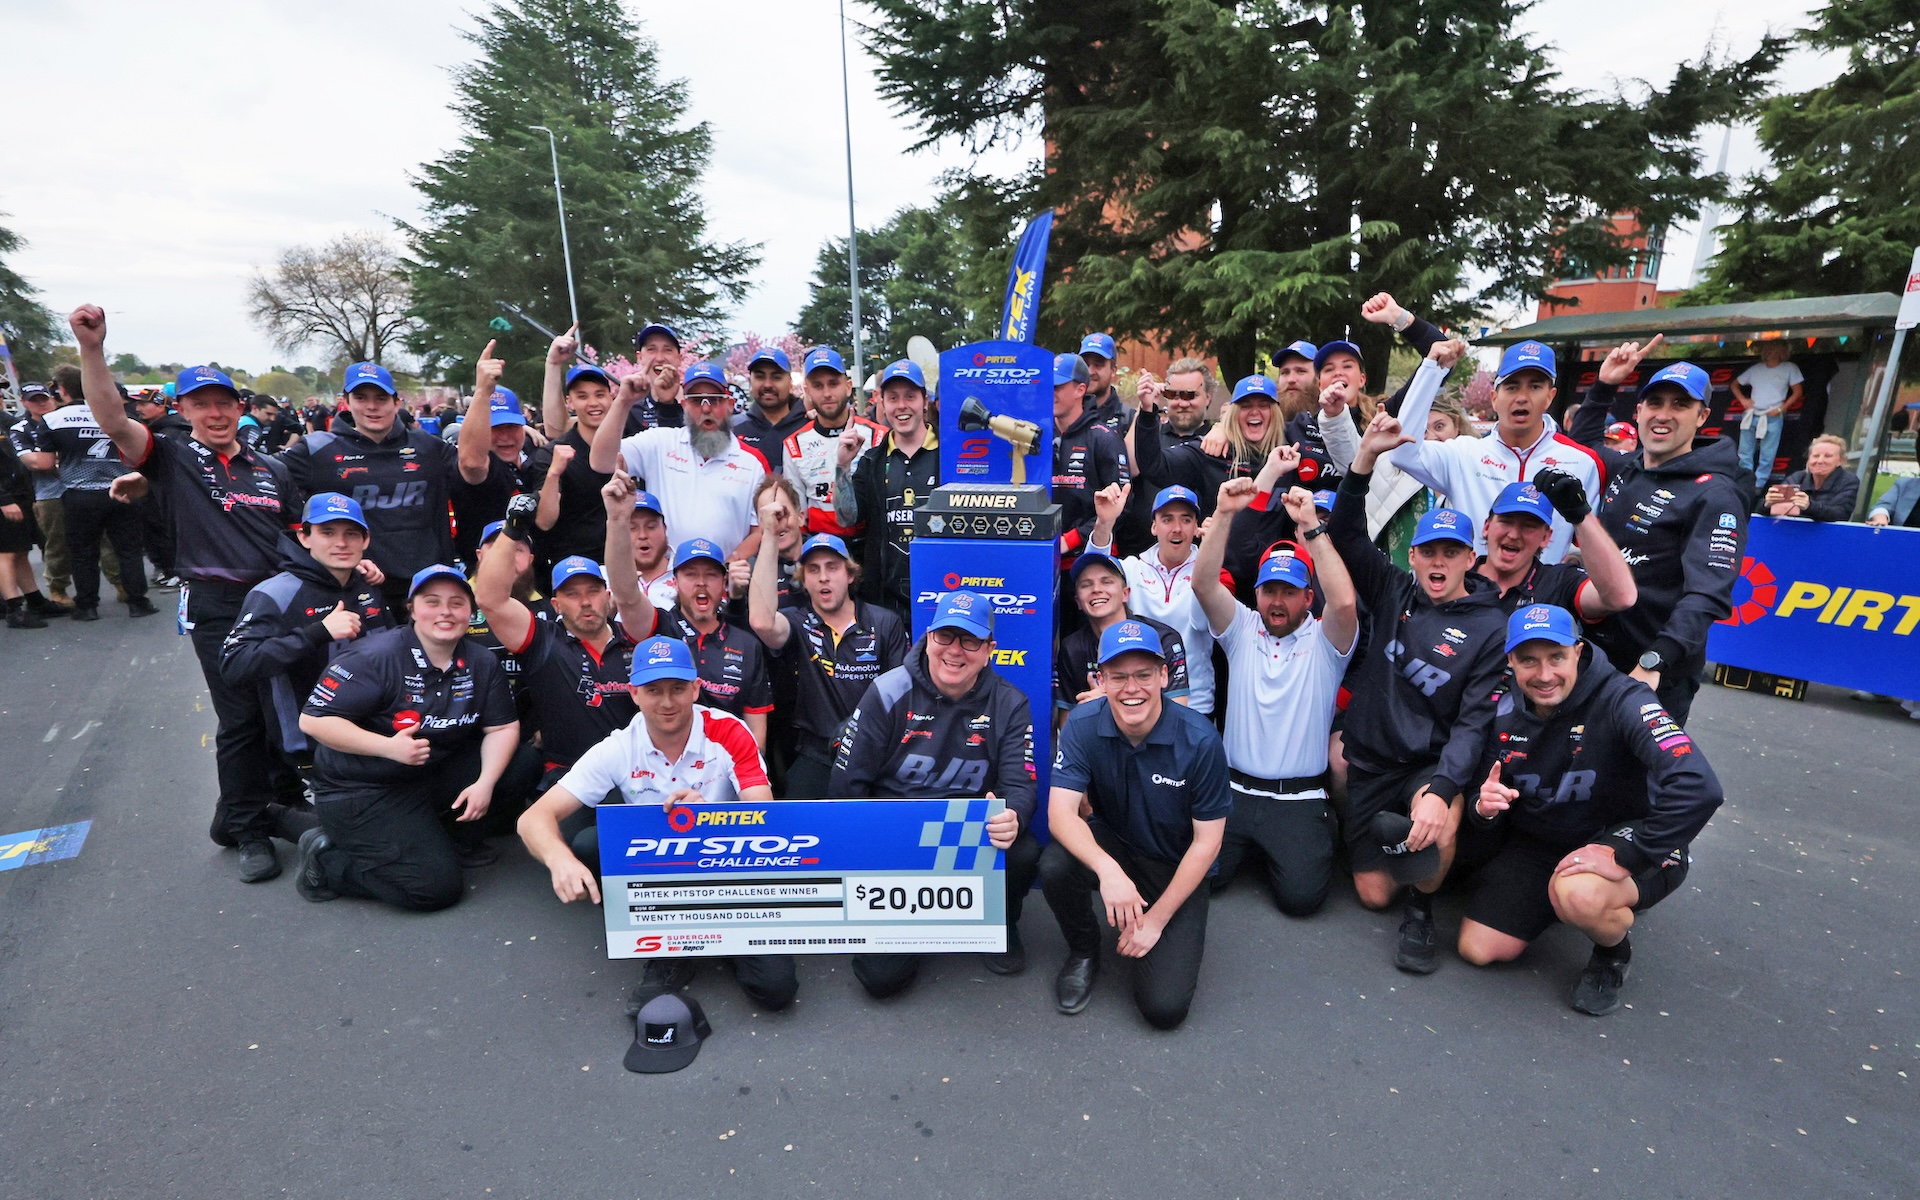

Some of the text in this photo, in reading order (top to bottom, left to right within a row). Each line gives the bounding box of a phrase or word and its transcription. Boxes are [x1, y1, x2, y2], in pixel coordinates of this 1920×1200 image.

[1024, 270, 1037, 309] LANE
[954, 368, 1040, 378] PIT STOP
[87, 439, 112, 459] 4
[352, 480, 428, 511] BJR
[949, 494, 1018, 508] WINNER
[961, 577, 1005, 588] PIRTEK
[1775, 581, 1920, 636] PIRT
[321, 676, 340, 691] 3M
[420, 712, 481, 729] Pizza Hut
[1671, 744, 1693, 757] 3M
[896, 753, 990, 792] BJR
[1162, 777, 1186, 787] PIRTEK
[696, 811, 767, 826] PIRTEK
[625, 835, 820, 857] PIT STOP
[697, 856, 801, 868] CHALLENGE
[634, 887, 818, 899] PIRTEK PITSTOP CHALLENGE WINNER
[856, 884, 973, 914] $20,000
[635, 911, 782, 922] TWENTY THOUSAND DOLLARS
